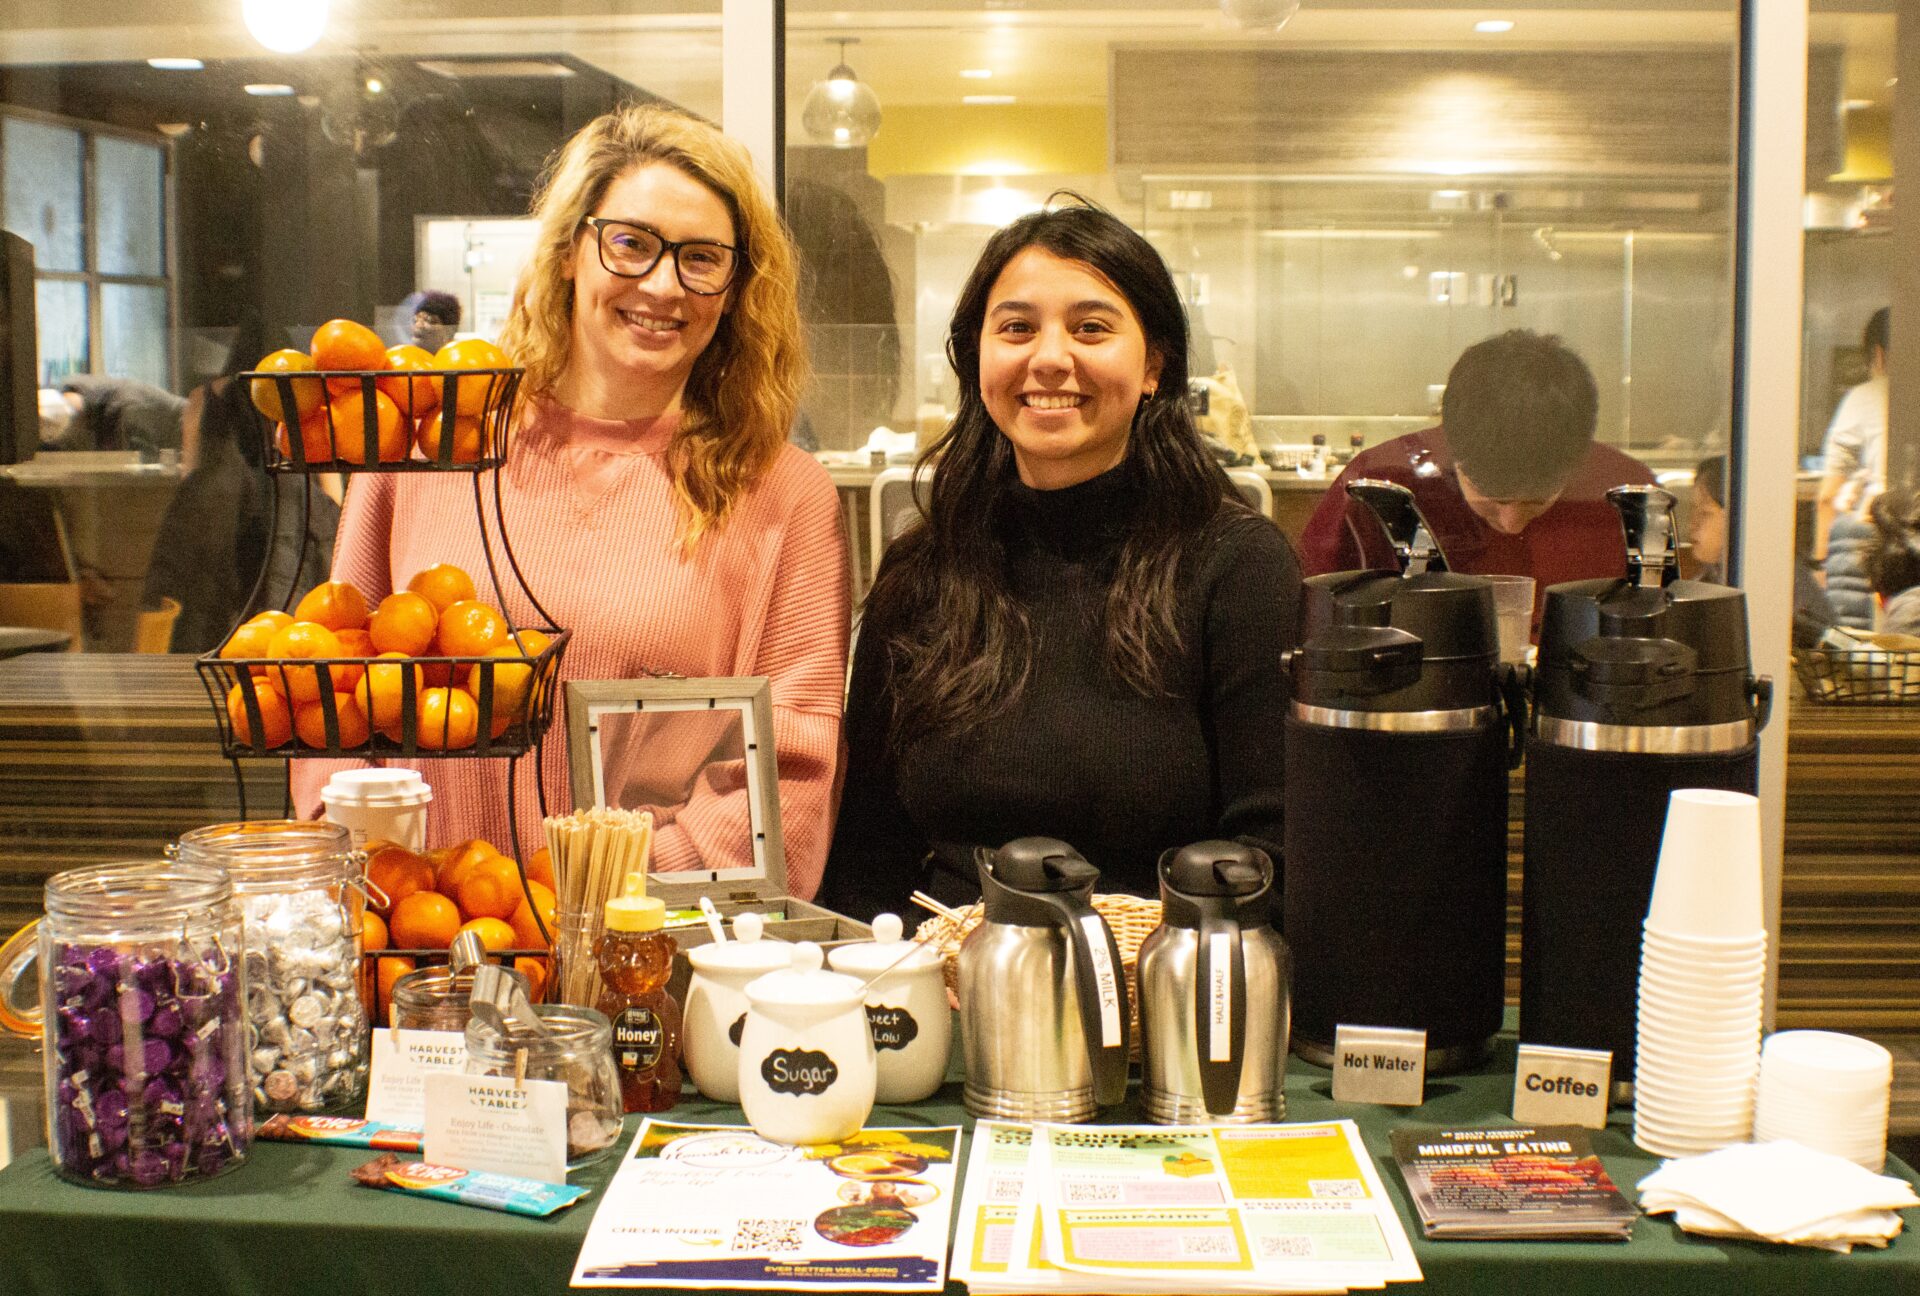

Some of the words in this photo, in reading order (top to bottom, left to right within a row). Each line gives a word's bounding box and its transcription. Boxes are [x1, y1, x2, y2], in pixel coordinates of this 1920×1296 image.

[1094, 948, 1106, 969] 2%
[1099, 972, 1117, 1008] MILK
[1215, 968, 1225, 1025] HALF&HALF
[867, 1012, 900, 1025] weet
[617, 1027, 658, 1044] Honey
[874, 1028, 900, 1043] Low
[409, 1044, 464, 1055] HARVEST
[418, 1055, 455, 1065] TABLE
[1342, 1052, 1369, 1070] Hot
[1373, 1054, 1417, 1073] Water
[772, 1056, 834, 1095] Sugar
[469, 1087, 529, 1100] HARVEST
[1524, 1073, 1600, 1098] Coffee
[479, 1098, 519, 1109] TABLE
[450, 1117, 476, 1129] Enjoy
[478, 1118, 494, 1130] Life
[502, 1122, 545, 1135] Chocolate
[1418, 1143, 1501, 1157] MINDFUL
[1503, 1141, 1573, 1154] EATING
[611, 1227, 662, 1235] CHECK
[764, 1265, 793, 1273] EVER
